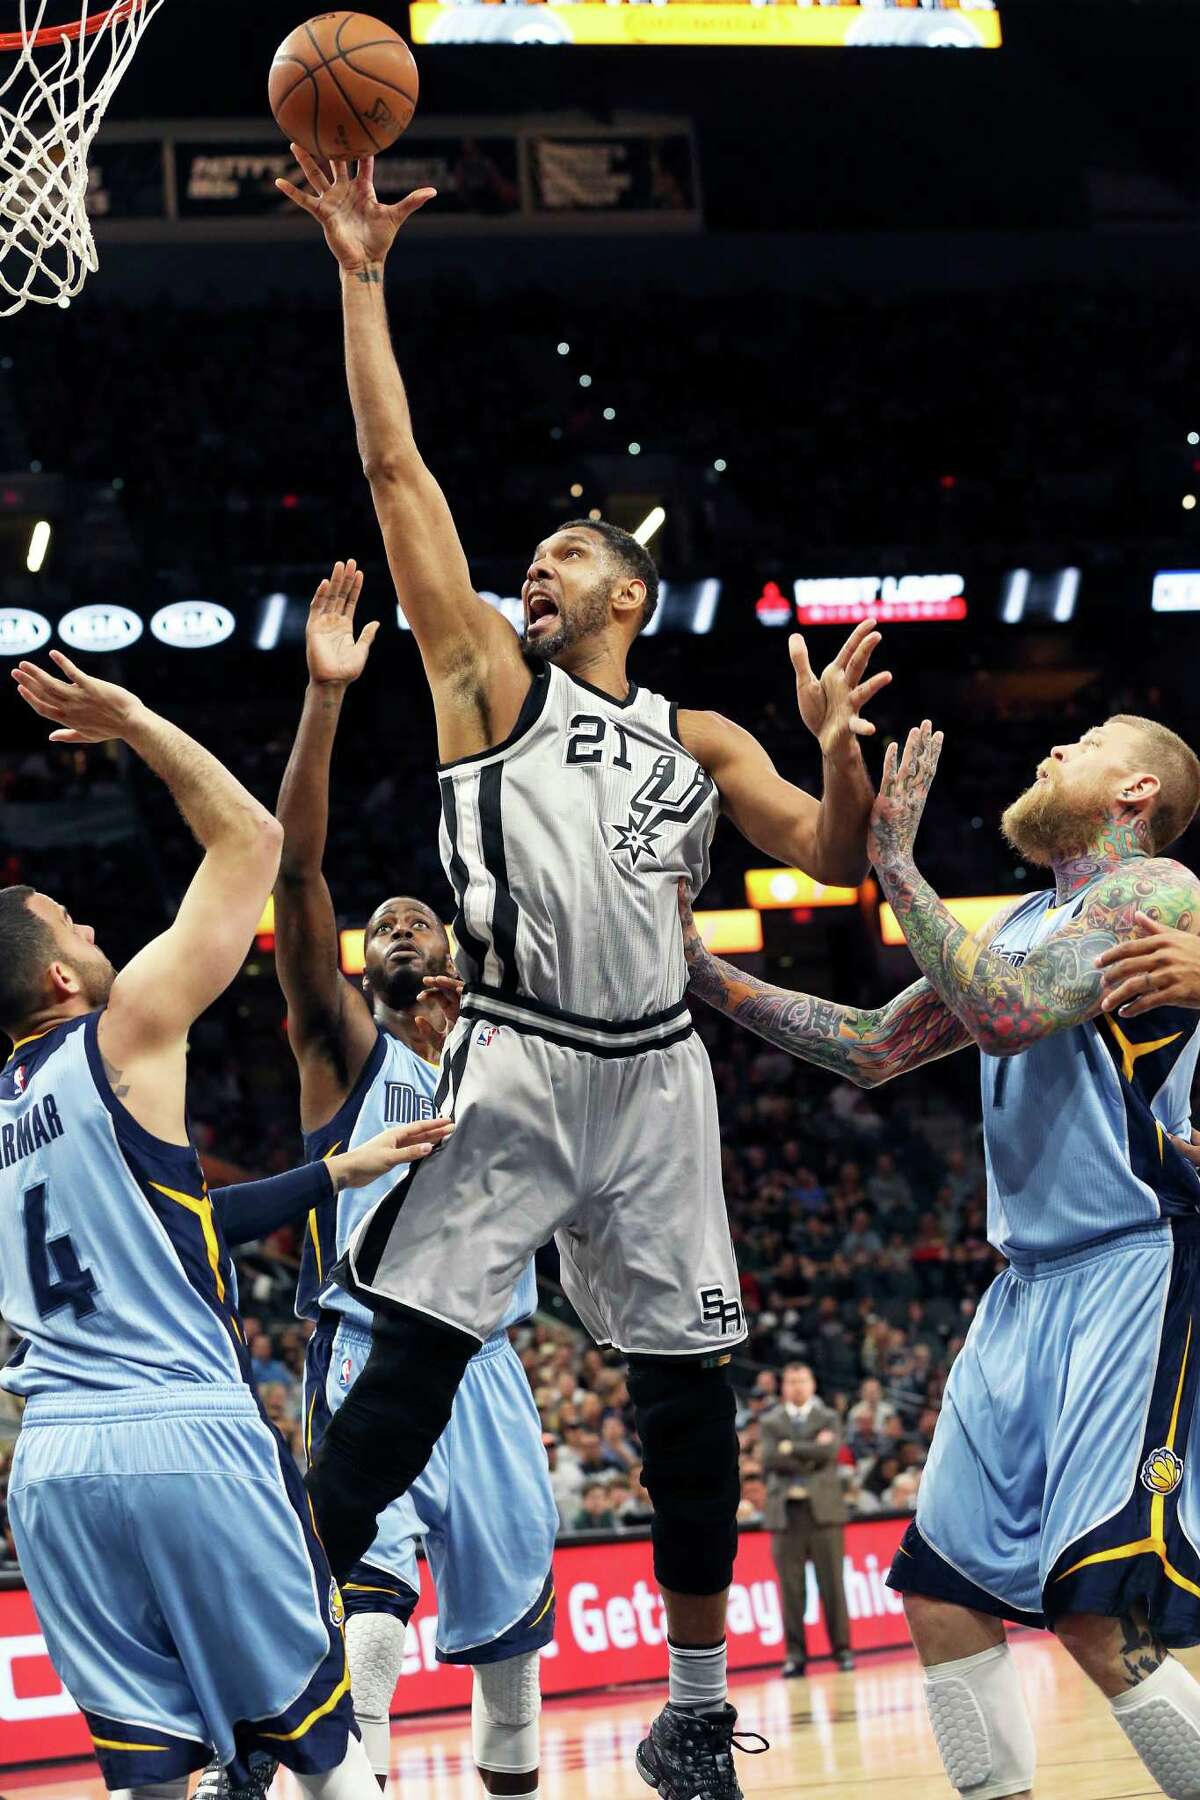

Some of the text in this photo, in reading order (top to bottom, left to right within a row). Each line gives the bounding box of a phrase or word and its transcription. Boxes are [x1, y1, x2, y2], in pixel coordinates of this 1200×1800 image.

[564, 713, 633, 773] 21
[23, 1181, 99, 1320] 4
[699, 1287, 741, 1335] SA
